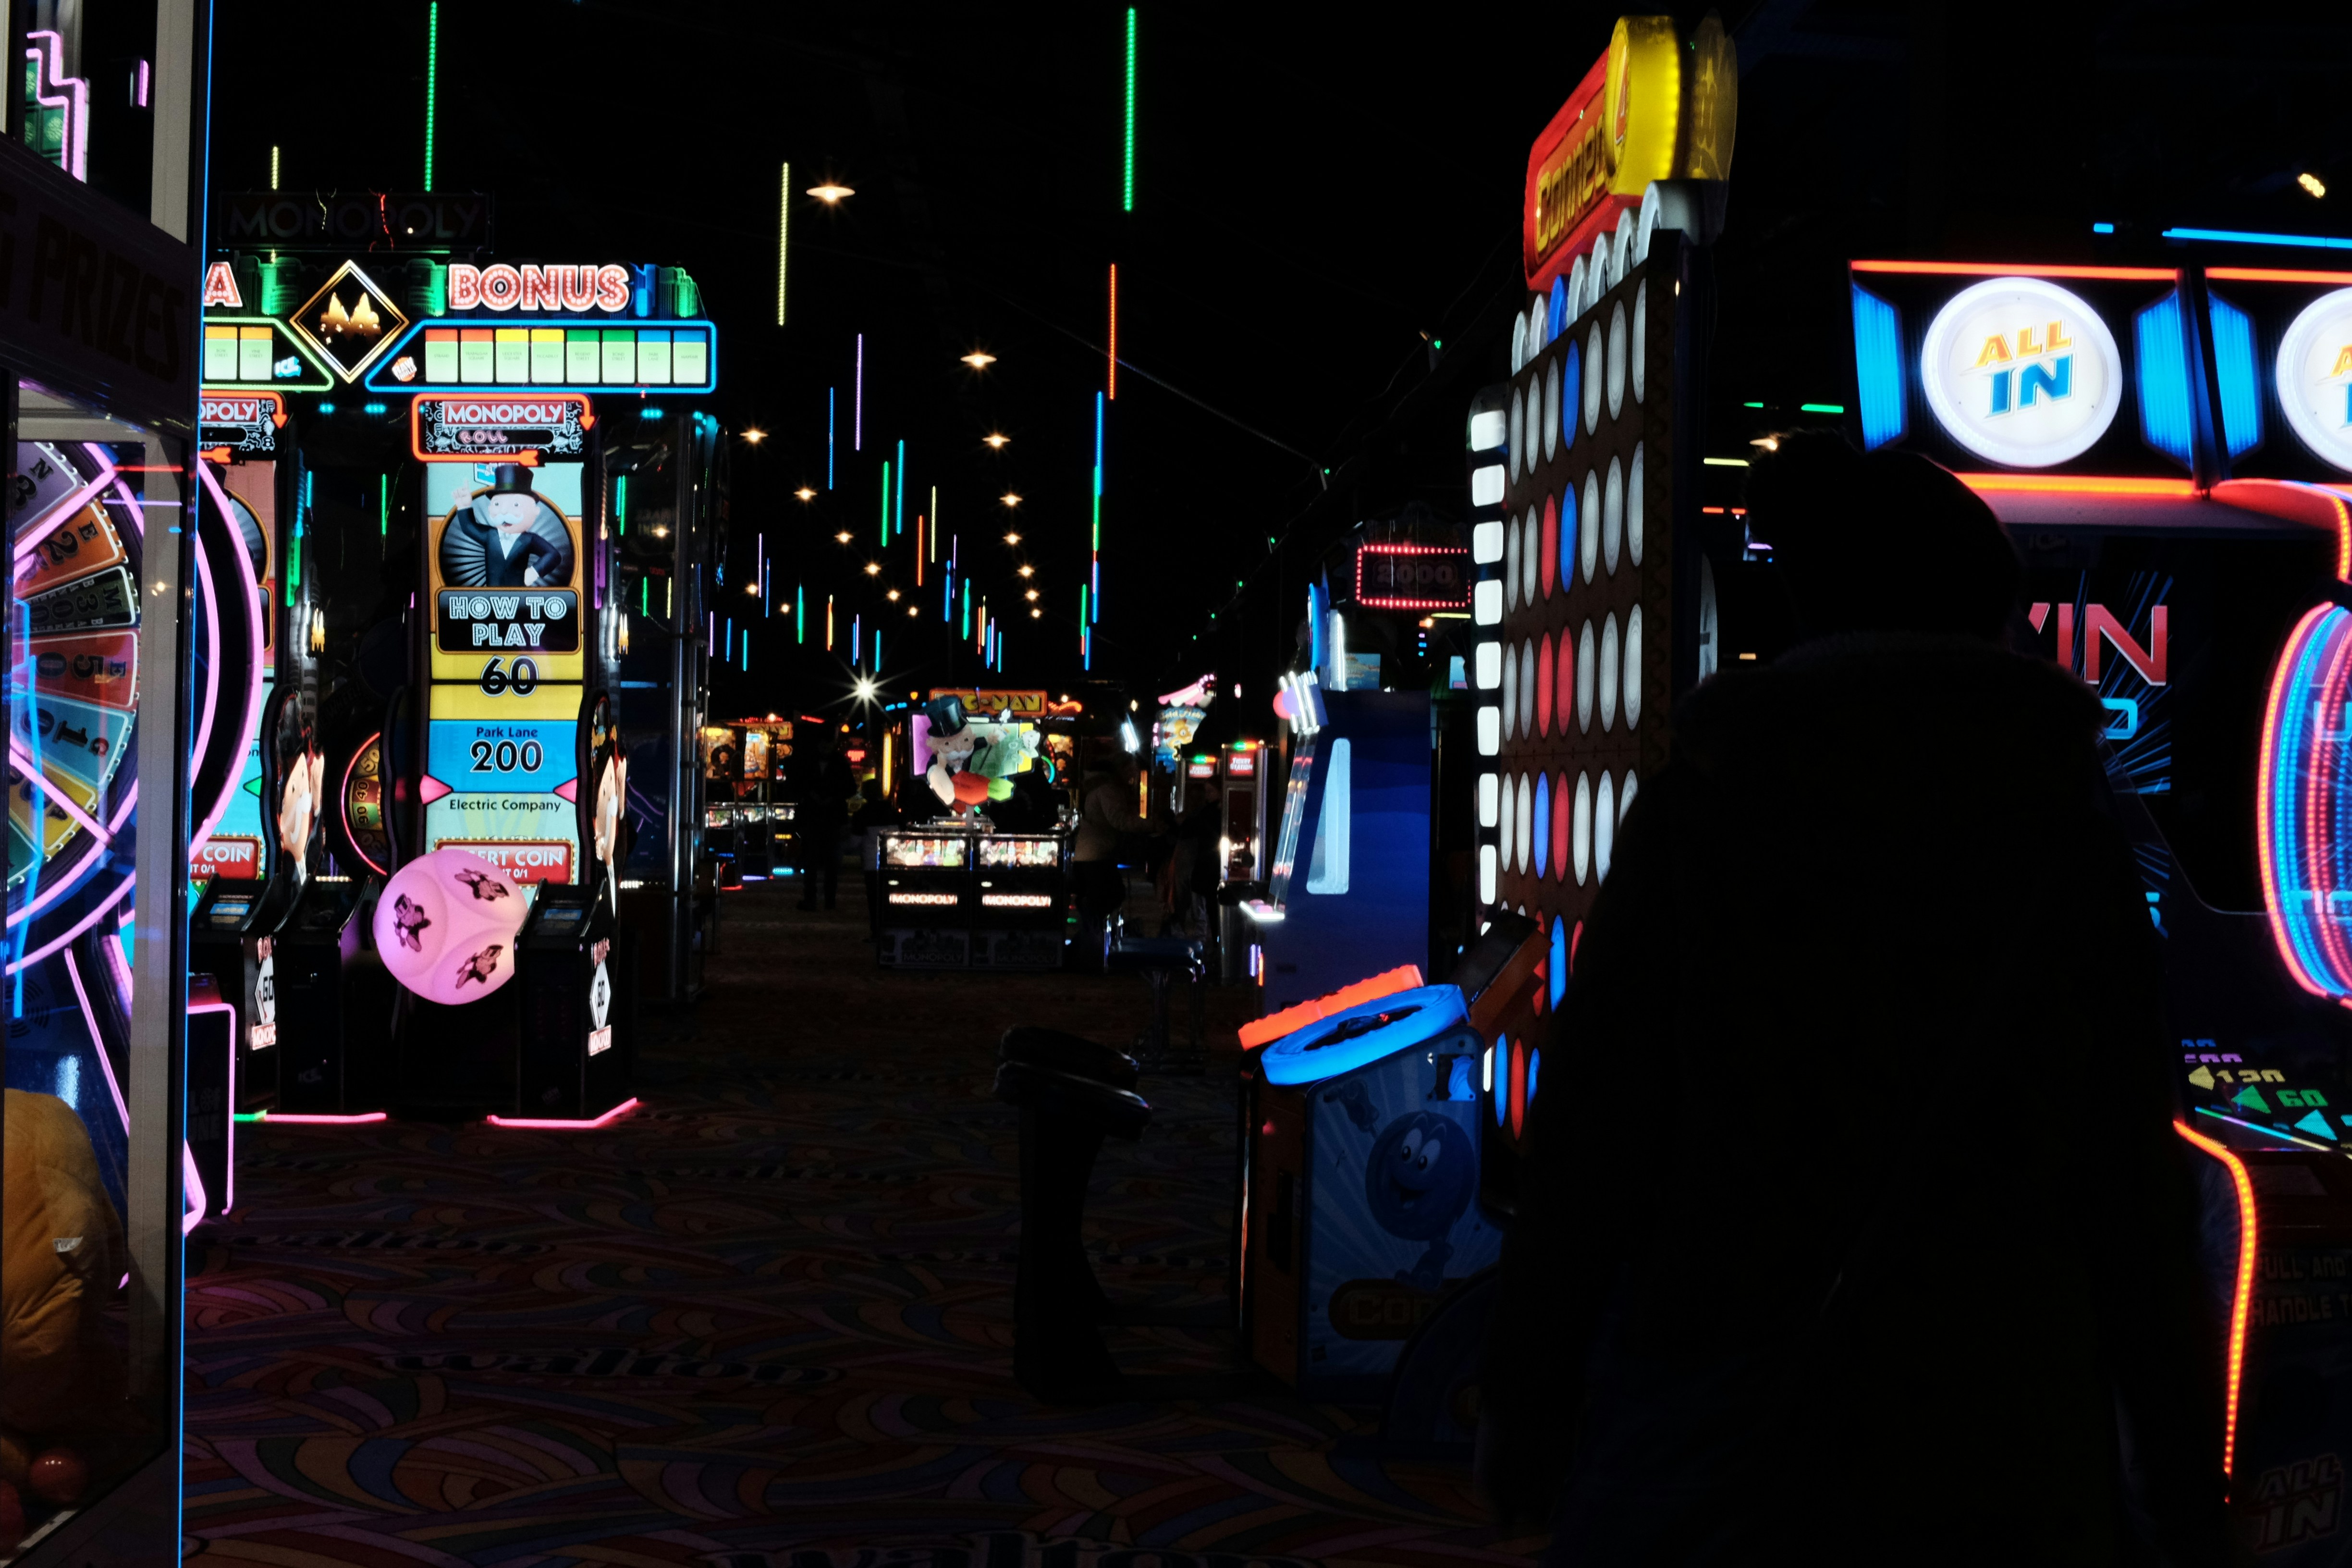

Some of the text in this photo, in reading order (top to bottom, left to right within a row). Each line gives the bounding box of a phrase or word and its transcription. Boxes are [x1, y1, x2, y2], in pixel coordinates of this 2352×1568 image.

[229, 200, 481, 239] MONOPOLY
[28, 209, 185, 383] PRIZES
[448, 264, 630, 312] BONUS
[1974, 320, 2072, 368] ALL
[1985, 353, 2074, 419] IN
[447, 404, 562, 423] MONOPOLY
[1376, 563, 1454, 586] 2000
[449, 597, 567, 620] HOW TO
[472, 623, 546, 647] PLAY
[2028, 602, 2168, 686] IN
[480, 655, 539, 697] 60
[476, 727, 538, 737] Park Lane
[359, 749, 380, 772] 50
[469, 739, 543, 773] 200
[355, 781, 369, 800] 40
[357, 806, 369, 825] 90
[449, 799, 561, 812] Electric Company
[203, 846, 250, 862] COIN
[469, 850, 564, 866] ERT COIN
[201, 864, 215, 873] 0/1
[514, 868, 528, 878] 0/1
[892, 894, 955, 904] MONOPOLY
[985, 895, 1048, 906] MONOPOLY
[903, 953, 962, 962] MONOPOLY
[375, 1347, 847, 1384] walton
[2259, 1456, 2338, 1499] ALL
[2262, 1490, 2336, 1545] IN
